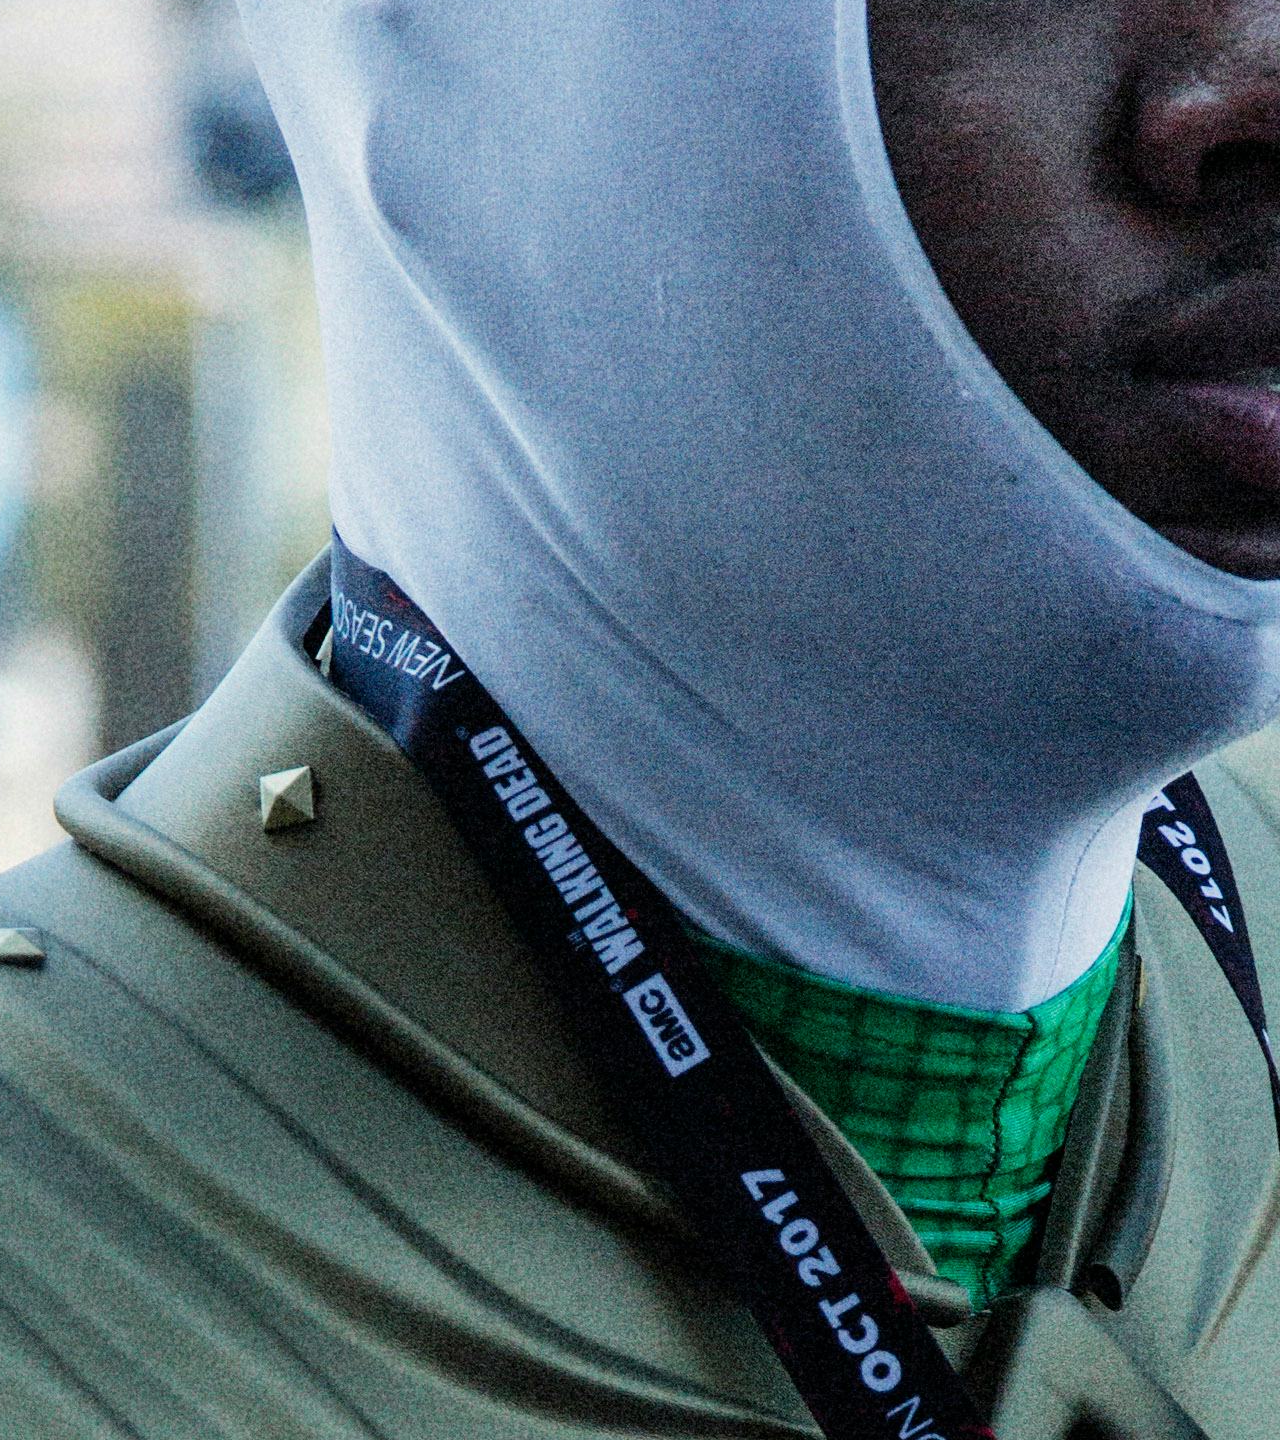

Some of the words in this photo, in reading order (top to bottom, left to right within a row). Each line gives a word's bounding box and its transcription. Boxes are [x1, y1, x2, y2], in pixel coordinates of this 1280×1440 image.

[333, 591, 394, 660] SEASO
[385, 629, 466, 692] NEW
[468, 724, 553, 824] DEAD
[522, 810, 647, 977] WALKING
[1157, 819, 1235, 934] 2017
[739, 1166, 843, 1289] 2017
[816, 1291, 904, 1394] OCT
